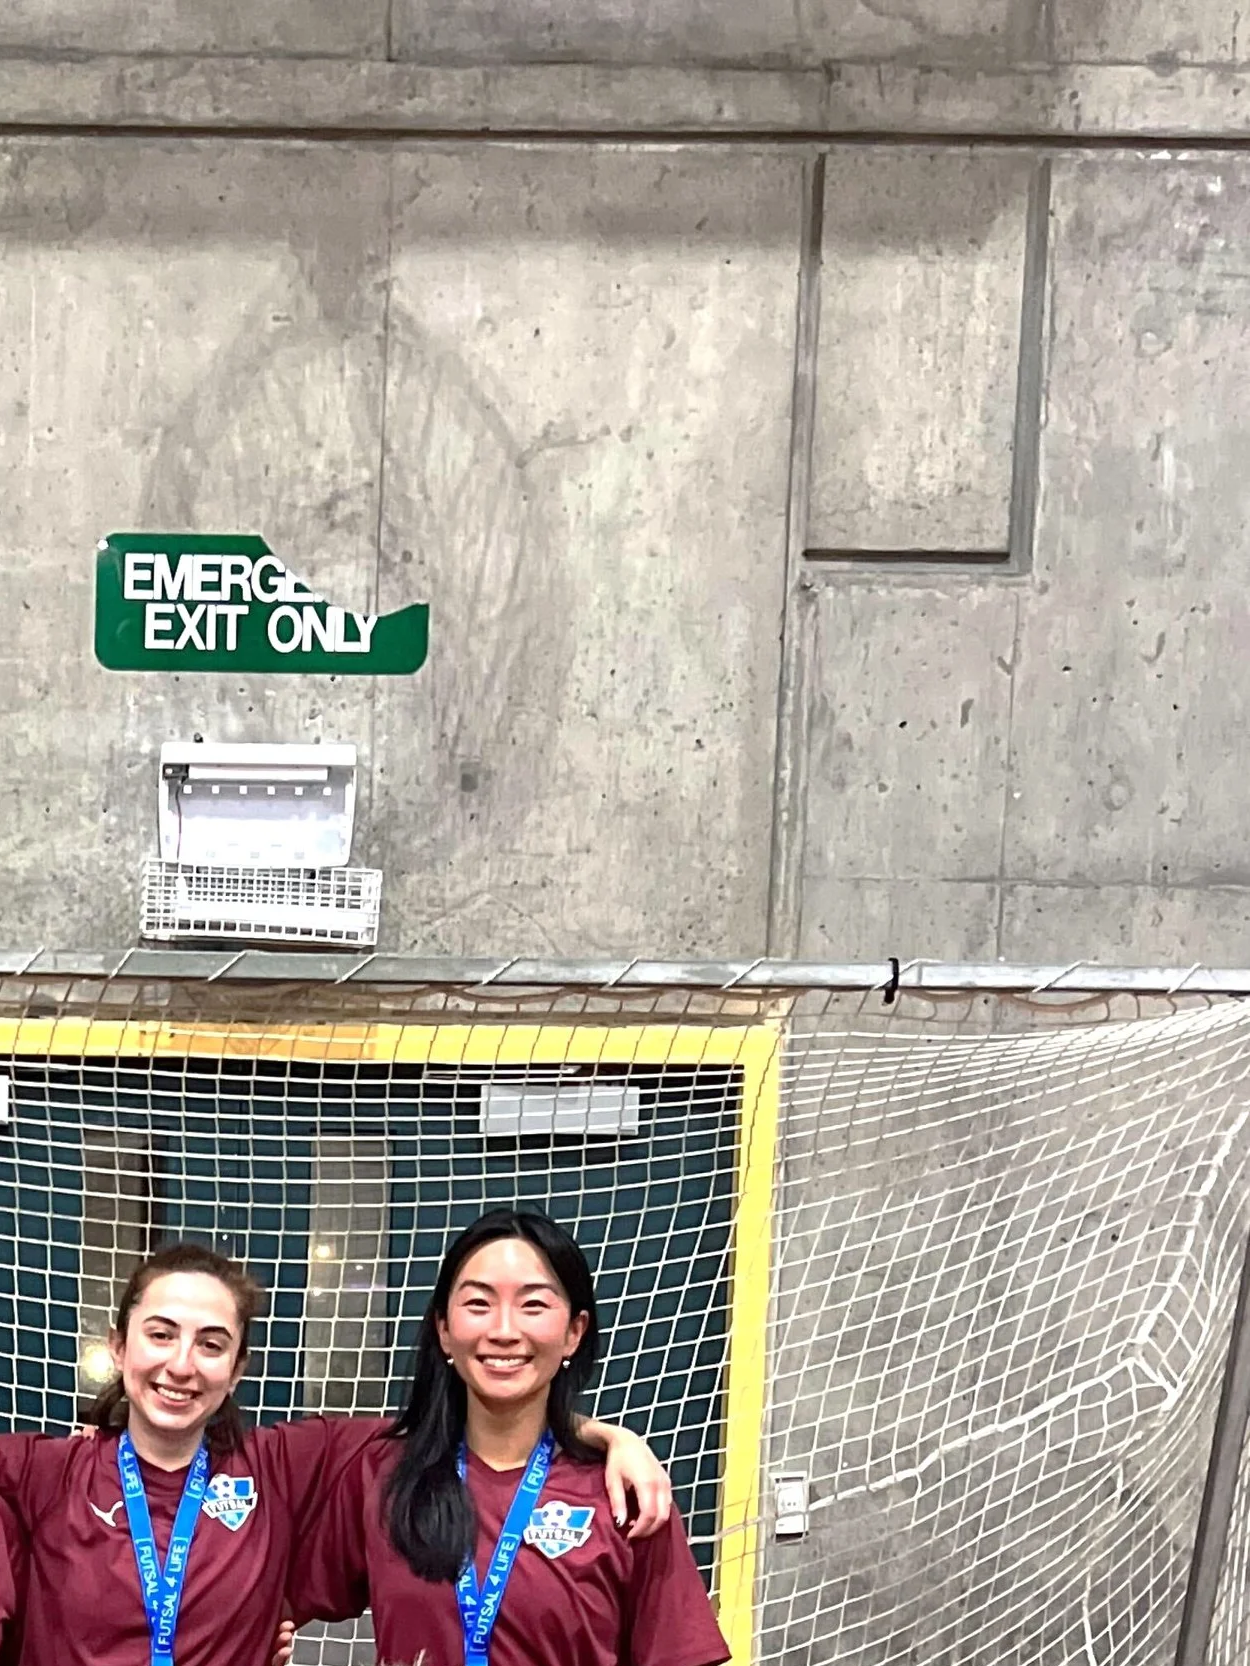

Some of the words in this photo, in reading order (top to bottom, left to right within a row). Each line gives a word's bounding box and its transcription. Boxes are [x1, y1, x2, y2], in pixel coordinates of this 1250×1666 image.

[124, 553, 324, 603] EMERGE
[145, 603, 249, 651] EXIT
[267, 605, 378, 653] ONLY
[163, 1575, 178, 1588] 4
[489, 1573, 503, 1587] 4
